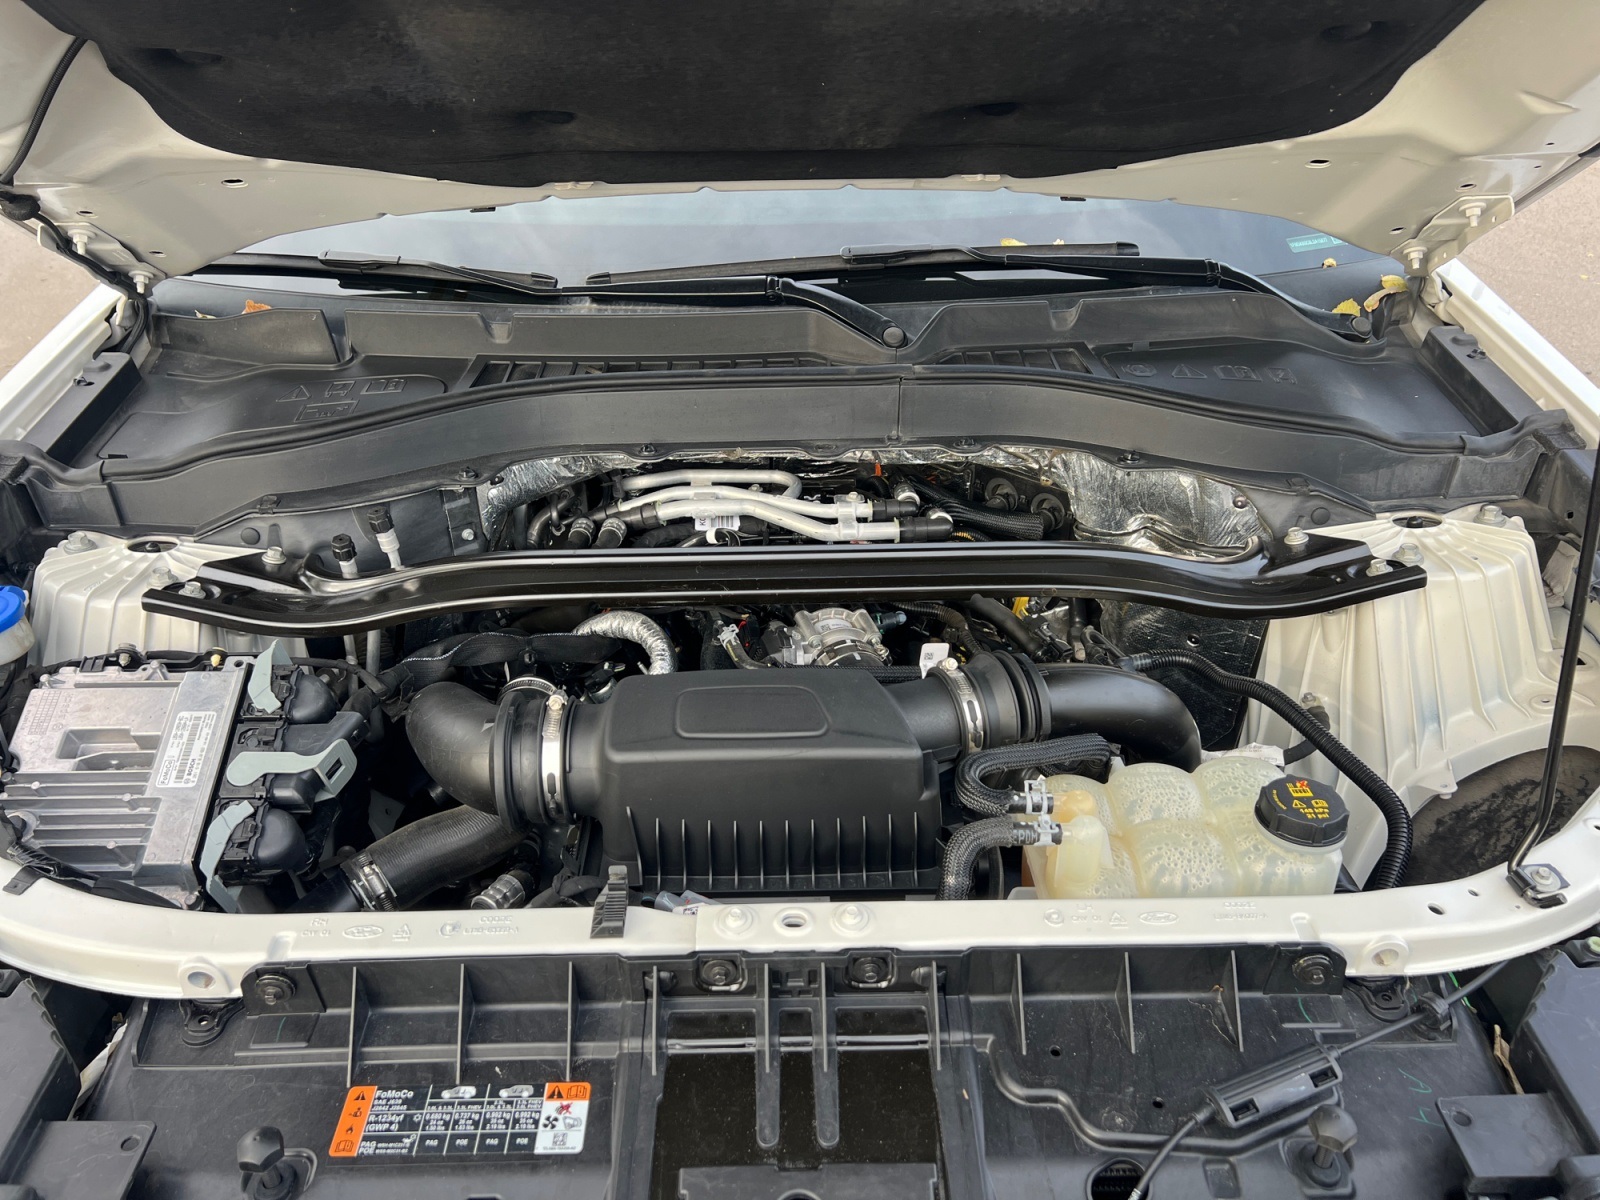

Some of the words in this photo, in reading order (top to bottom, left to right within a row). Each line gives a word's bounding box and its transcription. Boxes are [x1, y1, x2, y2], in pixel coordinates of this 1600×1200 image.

[186, 758, 196, 776] BOSCH
[160, 760, 172, 784] FoMoCo
[375, 1089, 414, 1099] FoMoCo
[368, 1114, 404, 1122] R-1234yf
[503, 1112, 511, 1120] kg
[532, 1111, 540, 1120] kg
[365, 1123, 390, 1132] (GWP
[390, 1123, 398, 1131] 4)
